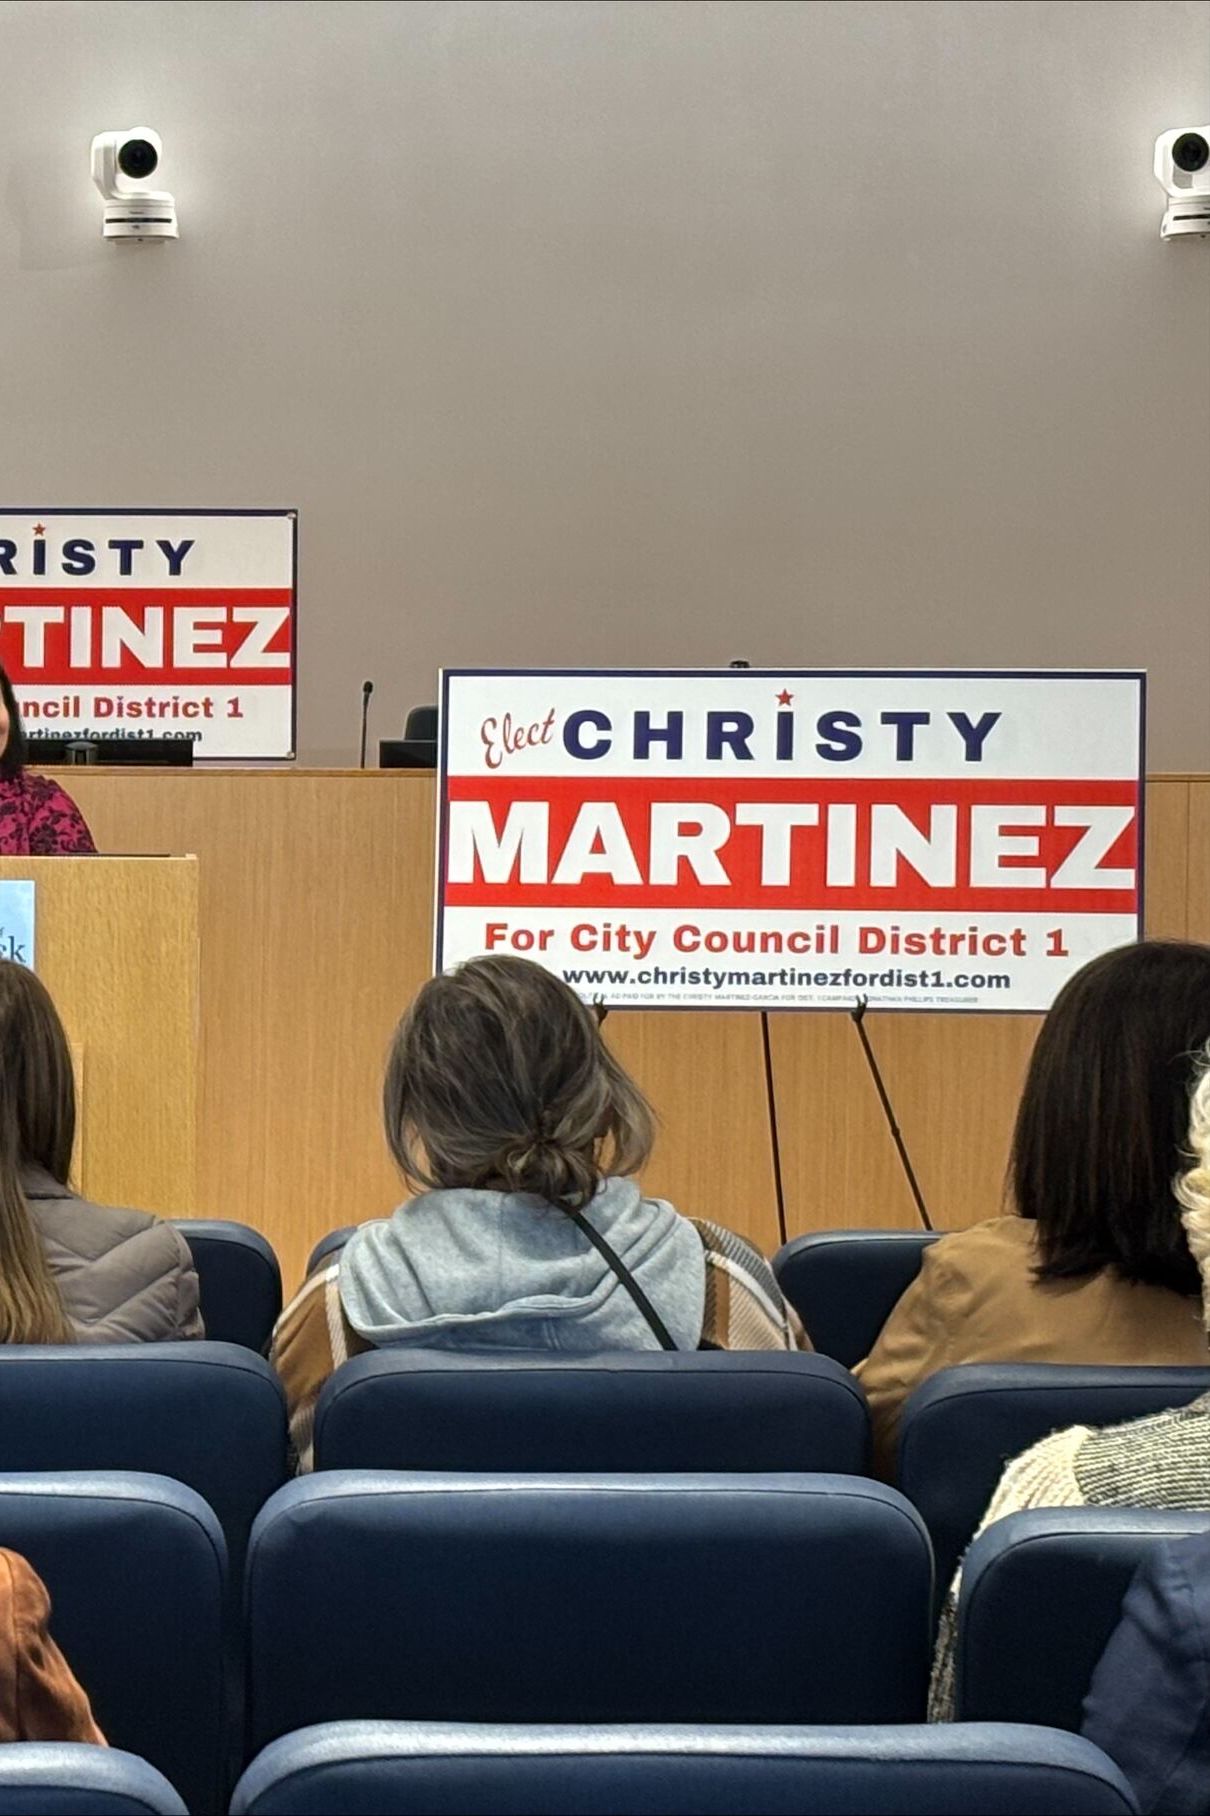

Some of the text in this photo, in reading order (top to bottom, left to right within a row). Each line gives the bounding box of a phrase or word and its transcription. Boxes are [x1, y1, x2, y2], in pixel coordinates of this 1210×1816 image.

[93, 695, 214, 718] District
[227, 697, 244, 717] 1
[481, 708, 1002, 769] Elect CHRISTY
[447, 800, 1136, 889] MARTINEZ
[485, 923, 1069, 959] For City Council District 1
[563, 966, 1011, 989] www.christymartinezfordist1.com
